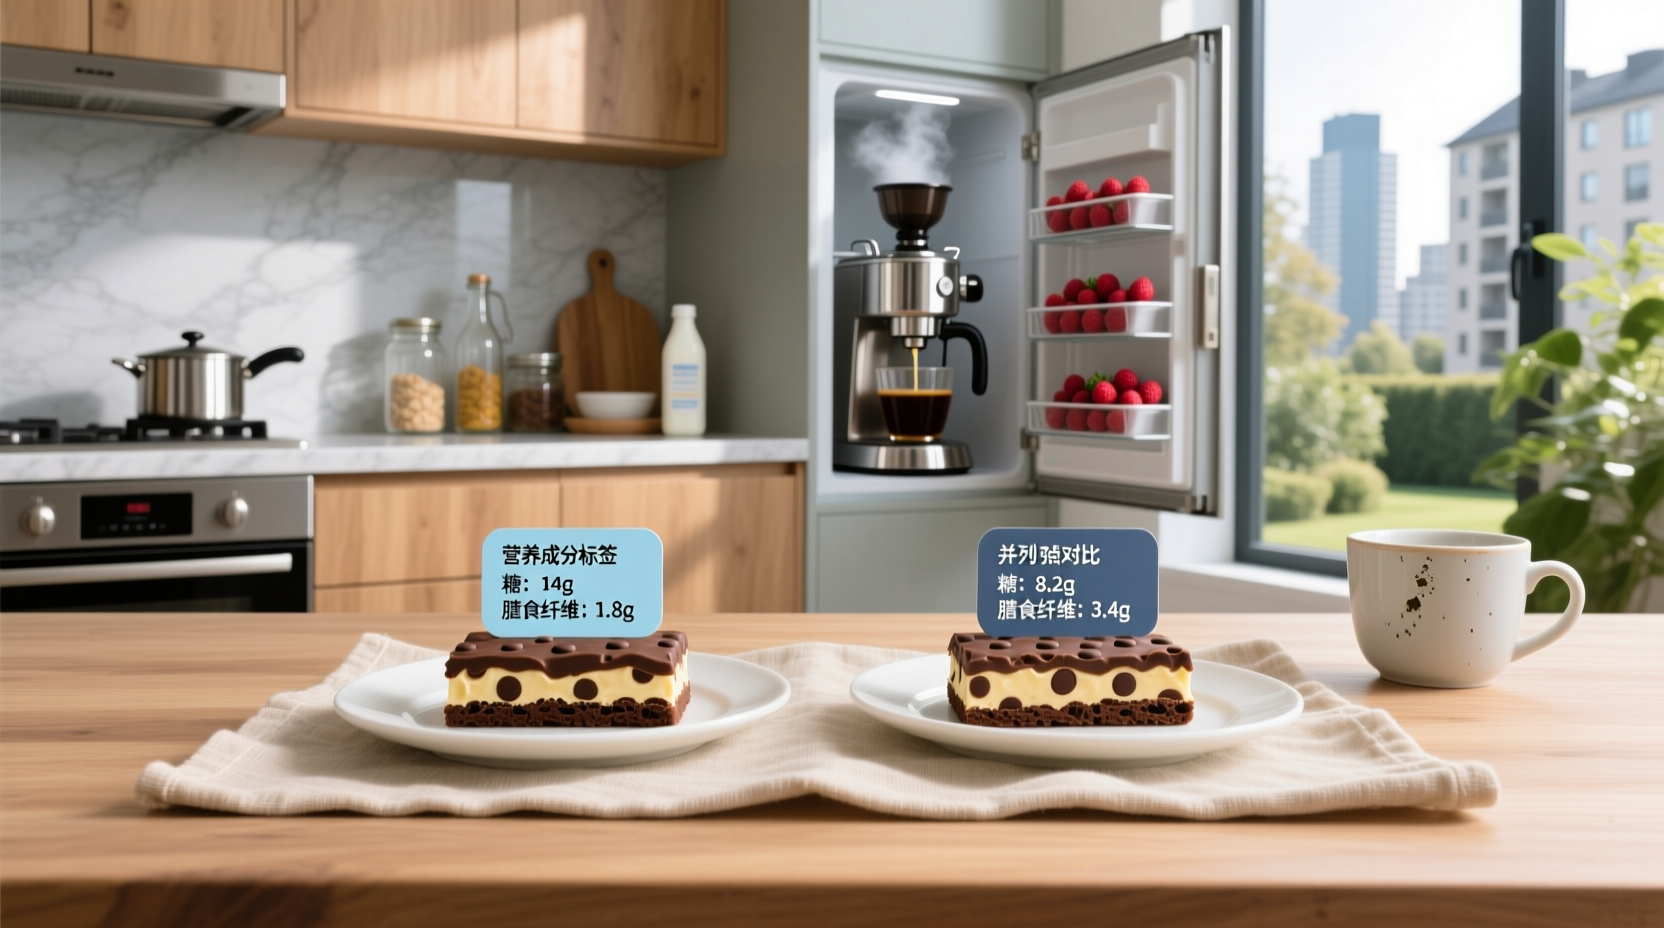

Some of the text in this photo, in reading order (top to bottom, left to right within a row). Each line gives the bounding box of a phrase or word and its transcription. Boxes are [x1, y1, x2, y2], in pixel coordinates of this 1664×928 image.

[502, 543, 618, 567] 营养成分标签
